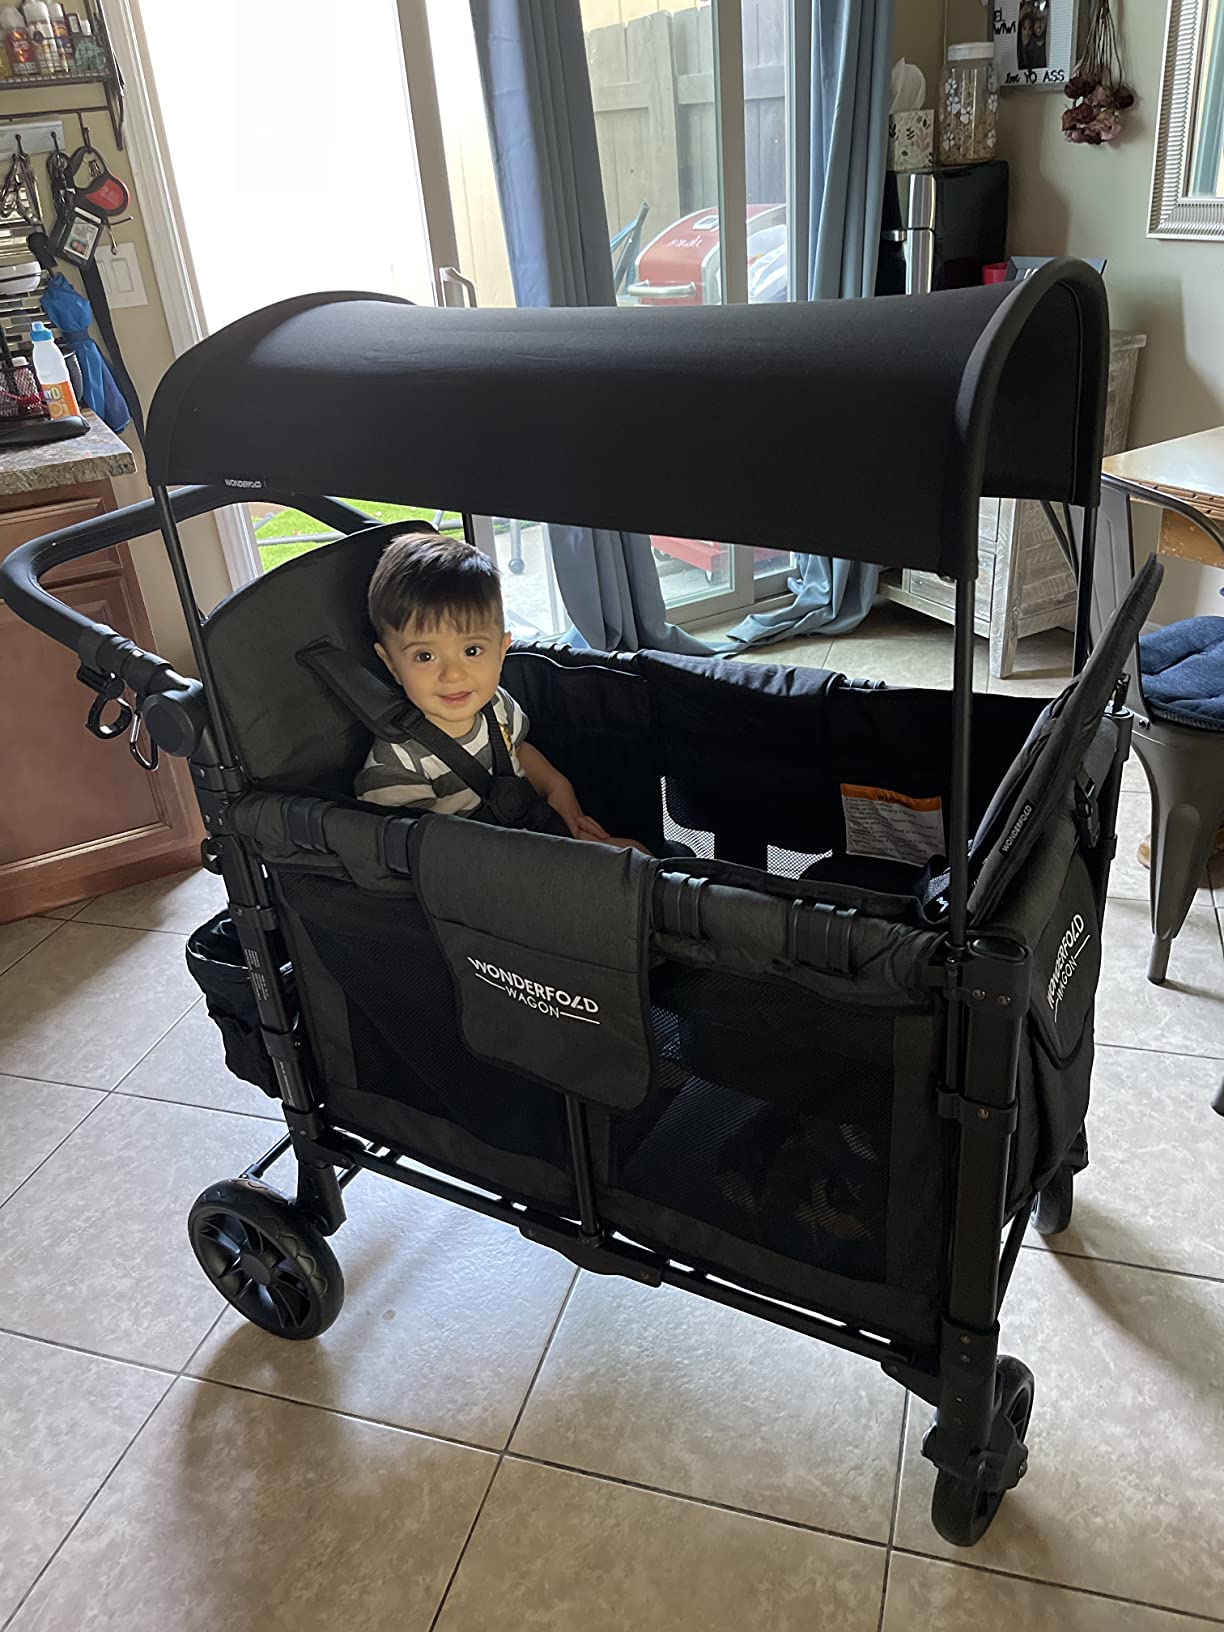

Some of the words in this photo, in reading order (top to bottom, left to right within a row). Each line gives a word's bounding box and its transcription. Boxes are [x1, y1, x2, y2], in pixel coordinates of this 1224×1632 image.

[1043, 69, 1065, 83] ASS
[1001, 804, 1033, 852] WONDERFOLD
[466, 956, 599, 1013] WONDERFOLD
[1046, 913, 1085, 1010] WONDERFOLD
[505, 986, 560, 1018] WAGON
